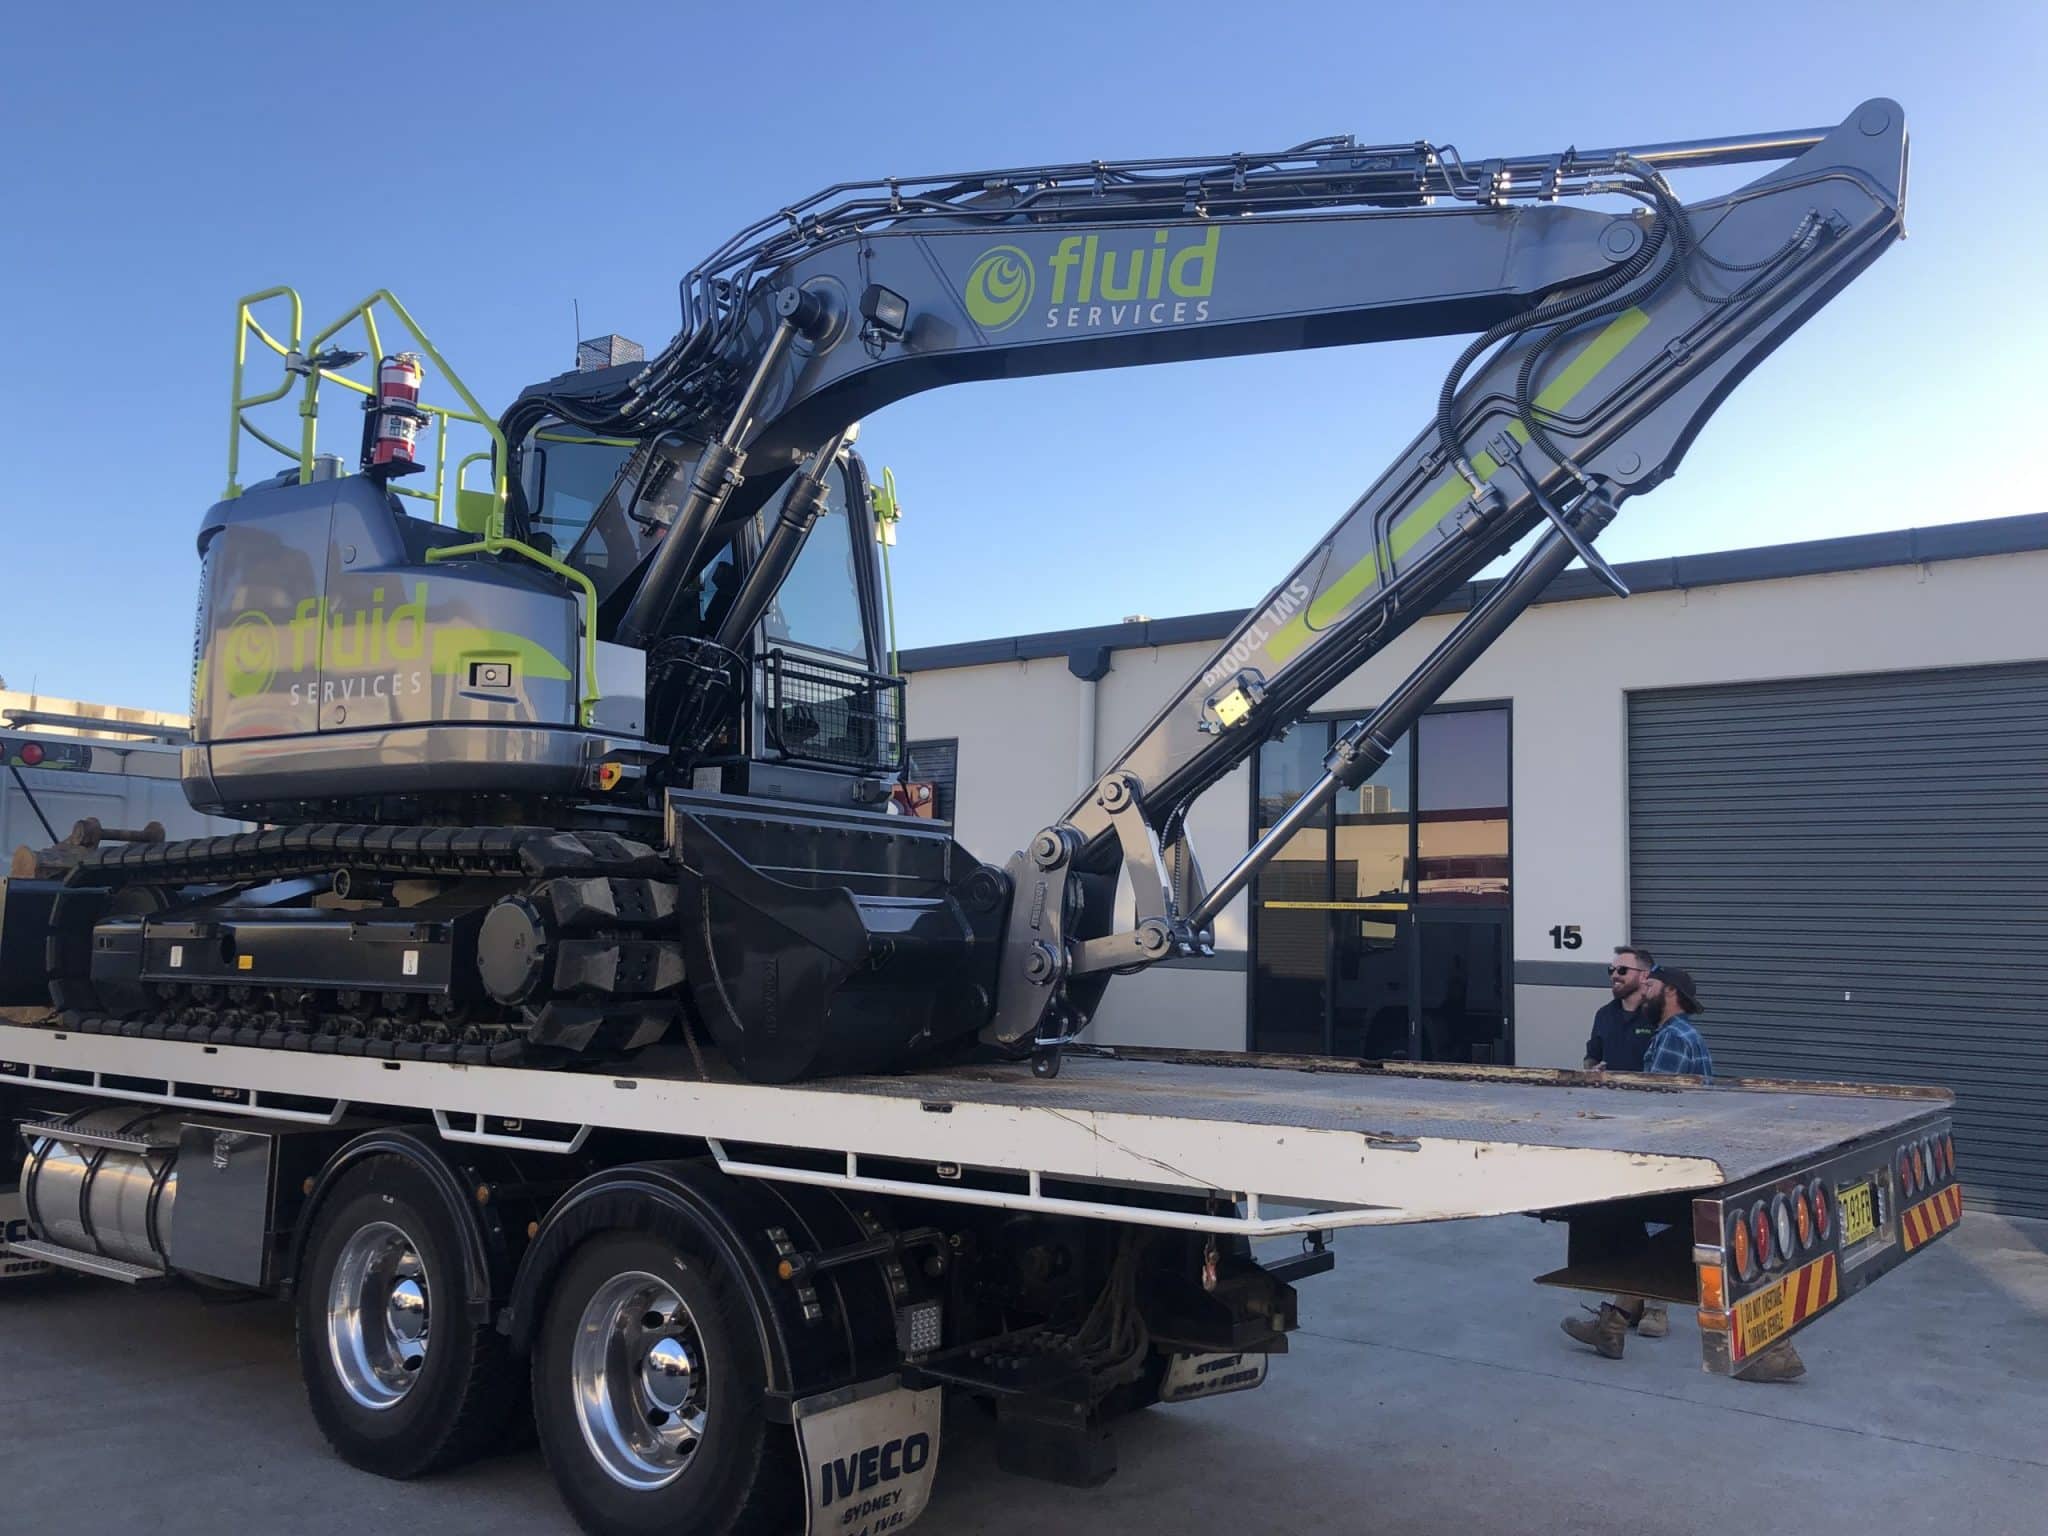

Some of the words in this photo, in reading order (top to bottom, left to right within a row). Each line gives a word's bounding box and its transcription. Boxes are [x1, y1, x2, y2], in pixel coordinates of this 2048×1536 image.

[1048, 225, 1221, 304] fluid
[1047, 300, 1209, 328] SERVICES
[1260, 577, 1309, 627] SWL
[287, 582, 428, 672] fluid
[289, 671, 423, 706] SERVICES
[1548, 924, 1583, 950] 15
[820, 1431, 930, 1508] IVECO
[842, 1488, 902, 1525] SYDNEY
